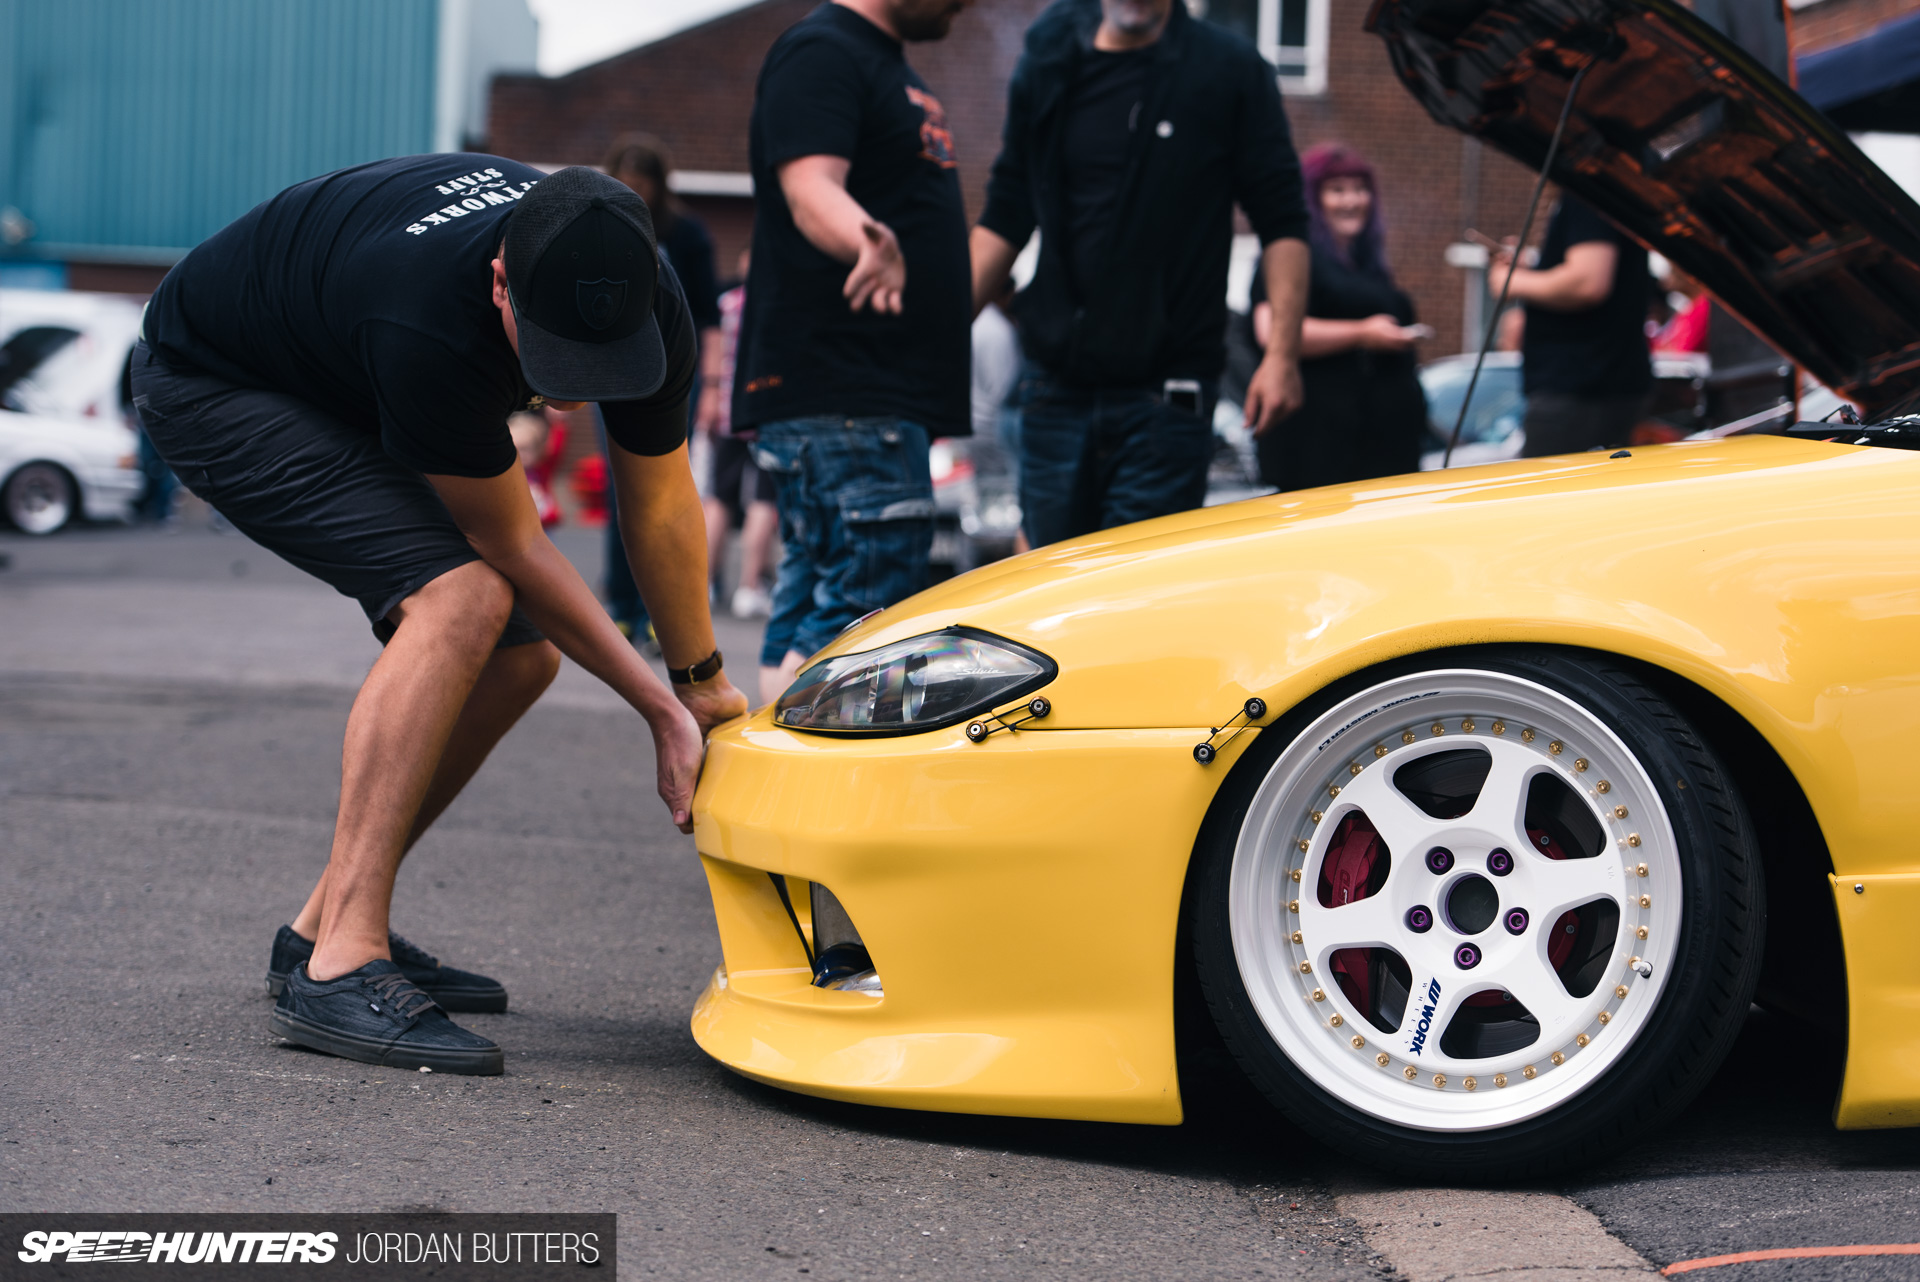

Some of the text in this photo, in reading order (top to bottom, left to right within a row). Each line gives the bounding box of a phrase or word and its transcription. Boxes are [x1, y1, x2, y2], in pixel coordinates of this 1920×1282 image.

[435, 168, 503, 195] STAFF
[956, 667, 1006, 675] Silvia
[1409, 1005, 1436, 1056] WORK
